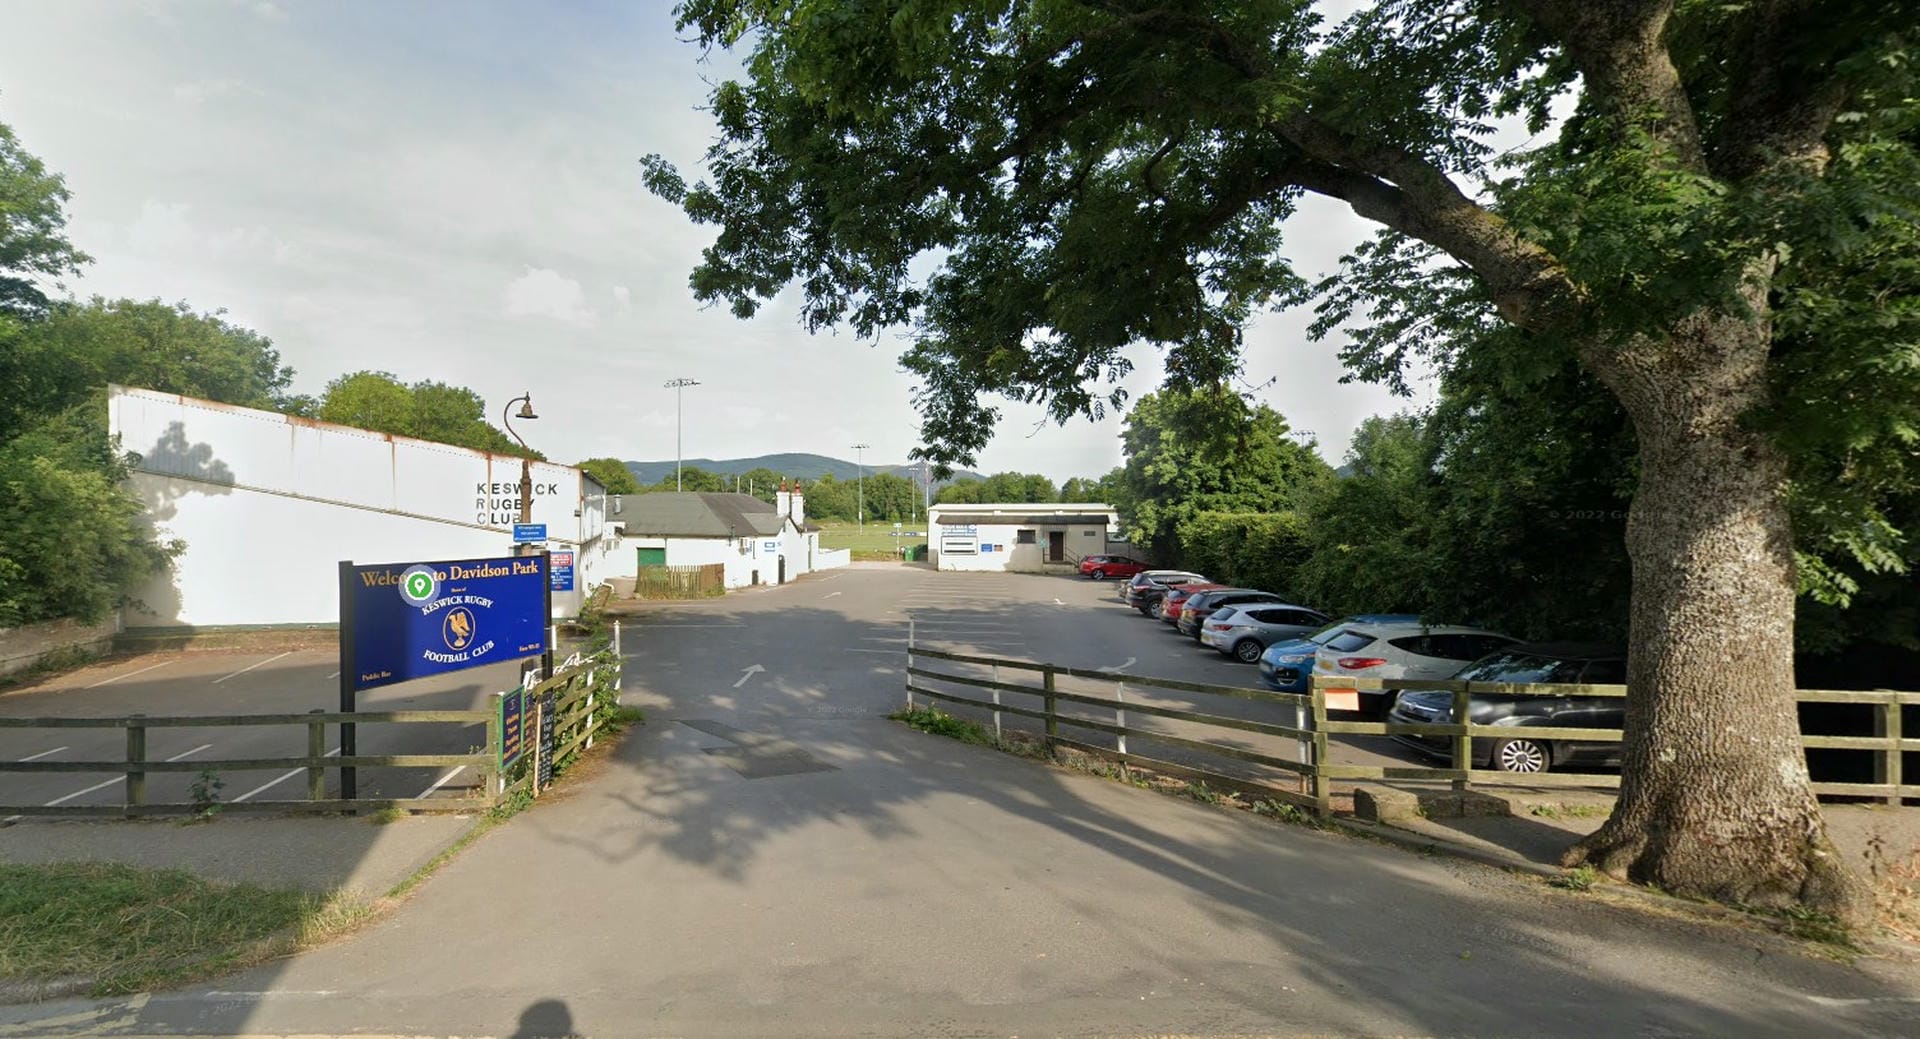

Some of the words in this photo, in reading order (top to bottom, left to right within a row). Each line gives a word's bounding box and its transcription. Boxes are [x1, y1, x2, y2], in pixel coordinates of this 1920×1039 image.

[476, 483, 557, 495] KESWCK
[360, 569, 411, 588] Welco
[432, 569, 448, 582] to
[450, 564, 509, 583] Davidson
[512, 560, 539, 575] Park
[421, 595, 464, 616] KESWICK
[464, 595, 494, 609] RUGBY
[423, 649, 471, 664] FOOTBALL
[472, 640, 495, 657] CLUB
